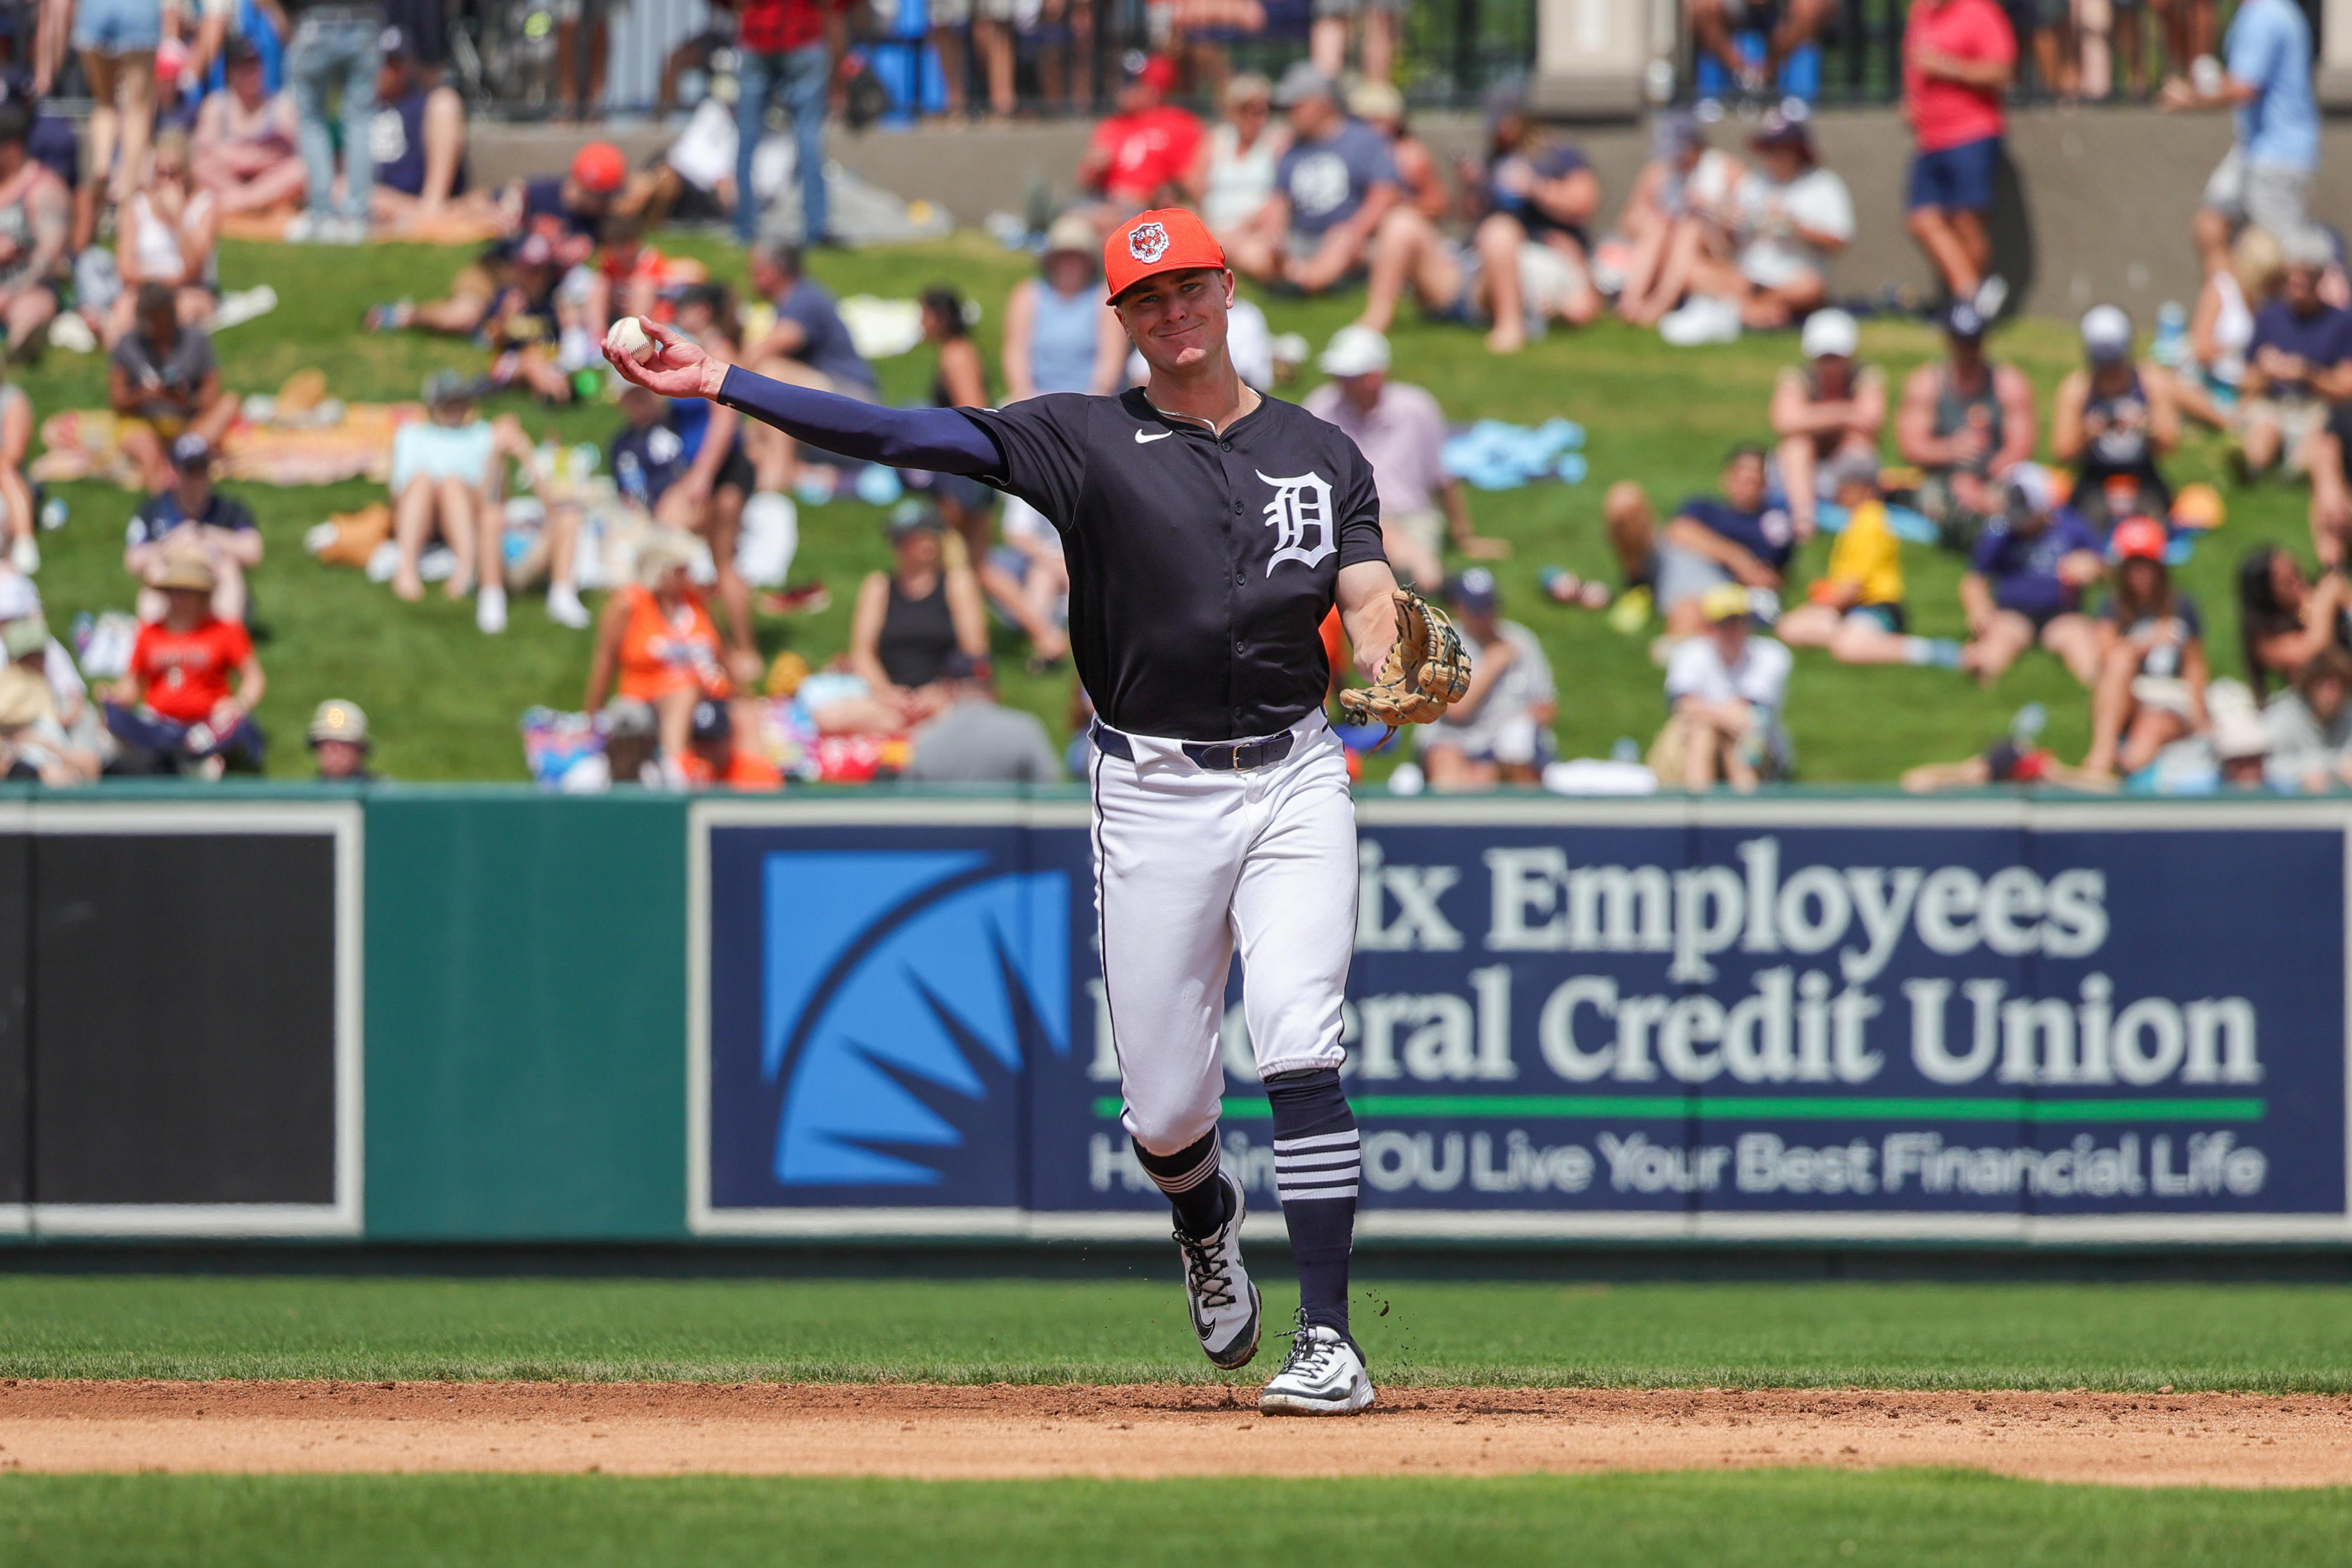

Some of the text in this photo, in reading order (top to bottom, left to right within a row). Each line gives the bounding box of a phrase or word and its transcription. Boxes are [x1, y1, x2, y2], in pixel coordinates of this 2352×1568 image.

[1255, 469, 1338, 579] D
[1483, 835, 2109, 984] Employees
[1538, 964, 1885, 1084] Credit
[1902, 972, 2263, 1085] Union
[1360, 1130, 2268, 1196] OU Live Your Best Financial Life
